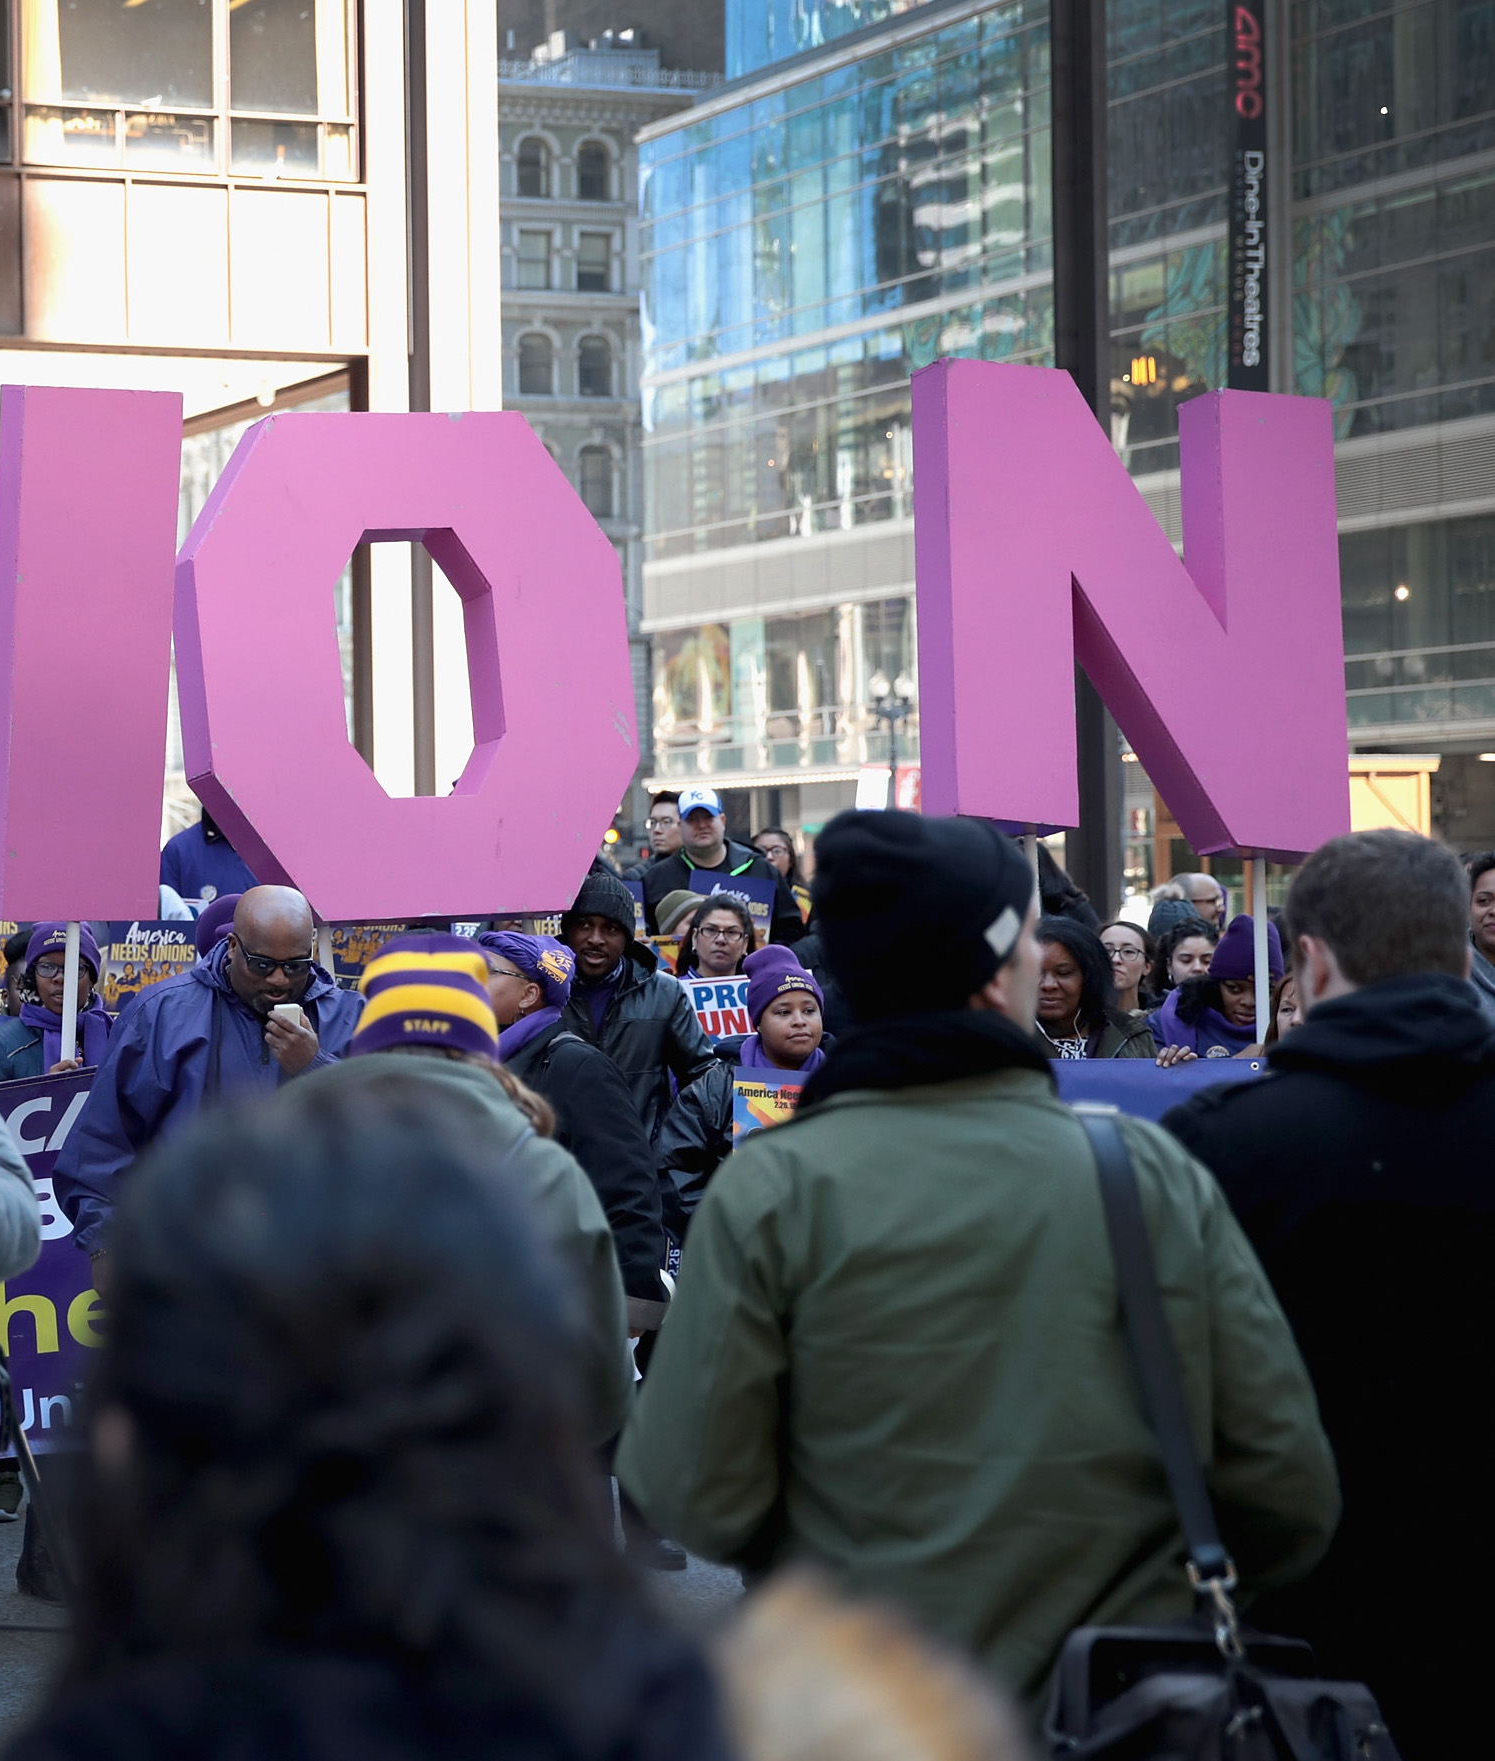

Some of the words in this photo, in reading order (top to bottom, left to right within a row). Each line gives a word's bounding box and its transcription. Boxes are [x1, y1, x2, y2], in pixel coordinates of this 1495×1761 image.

[1242, 245, 1266, 367] Theatres
[690, 790, 704, 801] KC
[125, 921, 187, 955] America
[110, 943, 149, 961] NEEDS
[151, 943, 196, 963] UNIONS
[403, 1018, 452, 1035] STAFF
[737, 1086, 779, 1099] America
[780, 1089, 801, 1100] Nee
